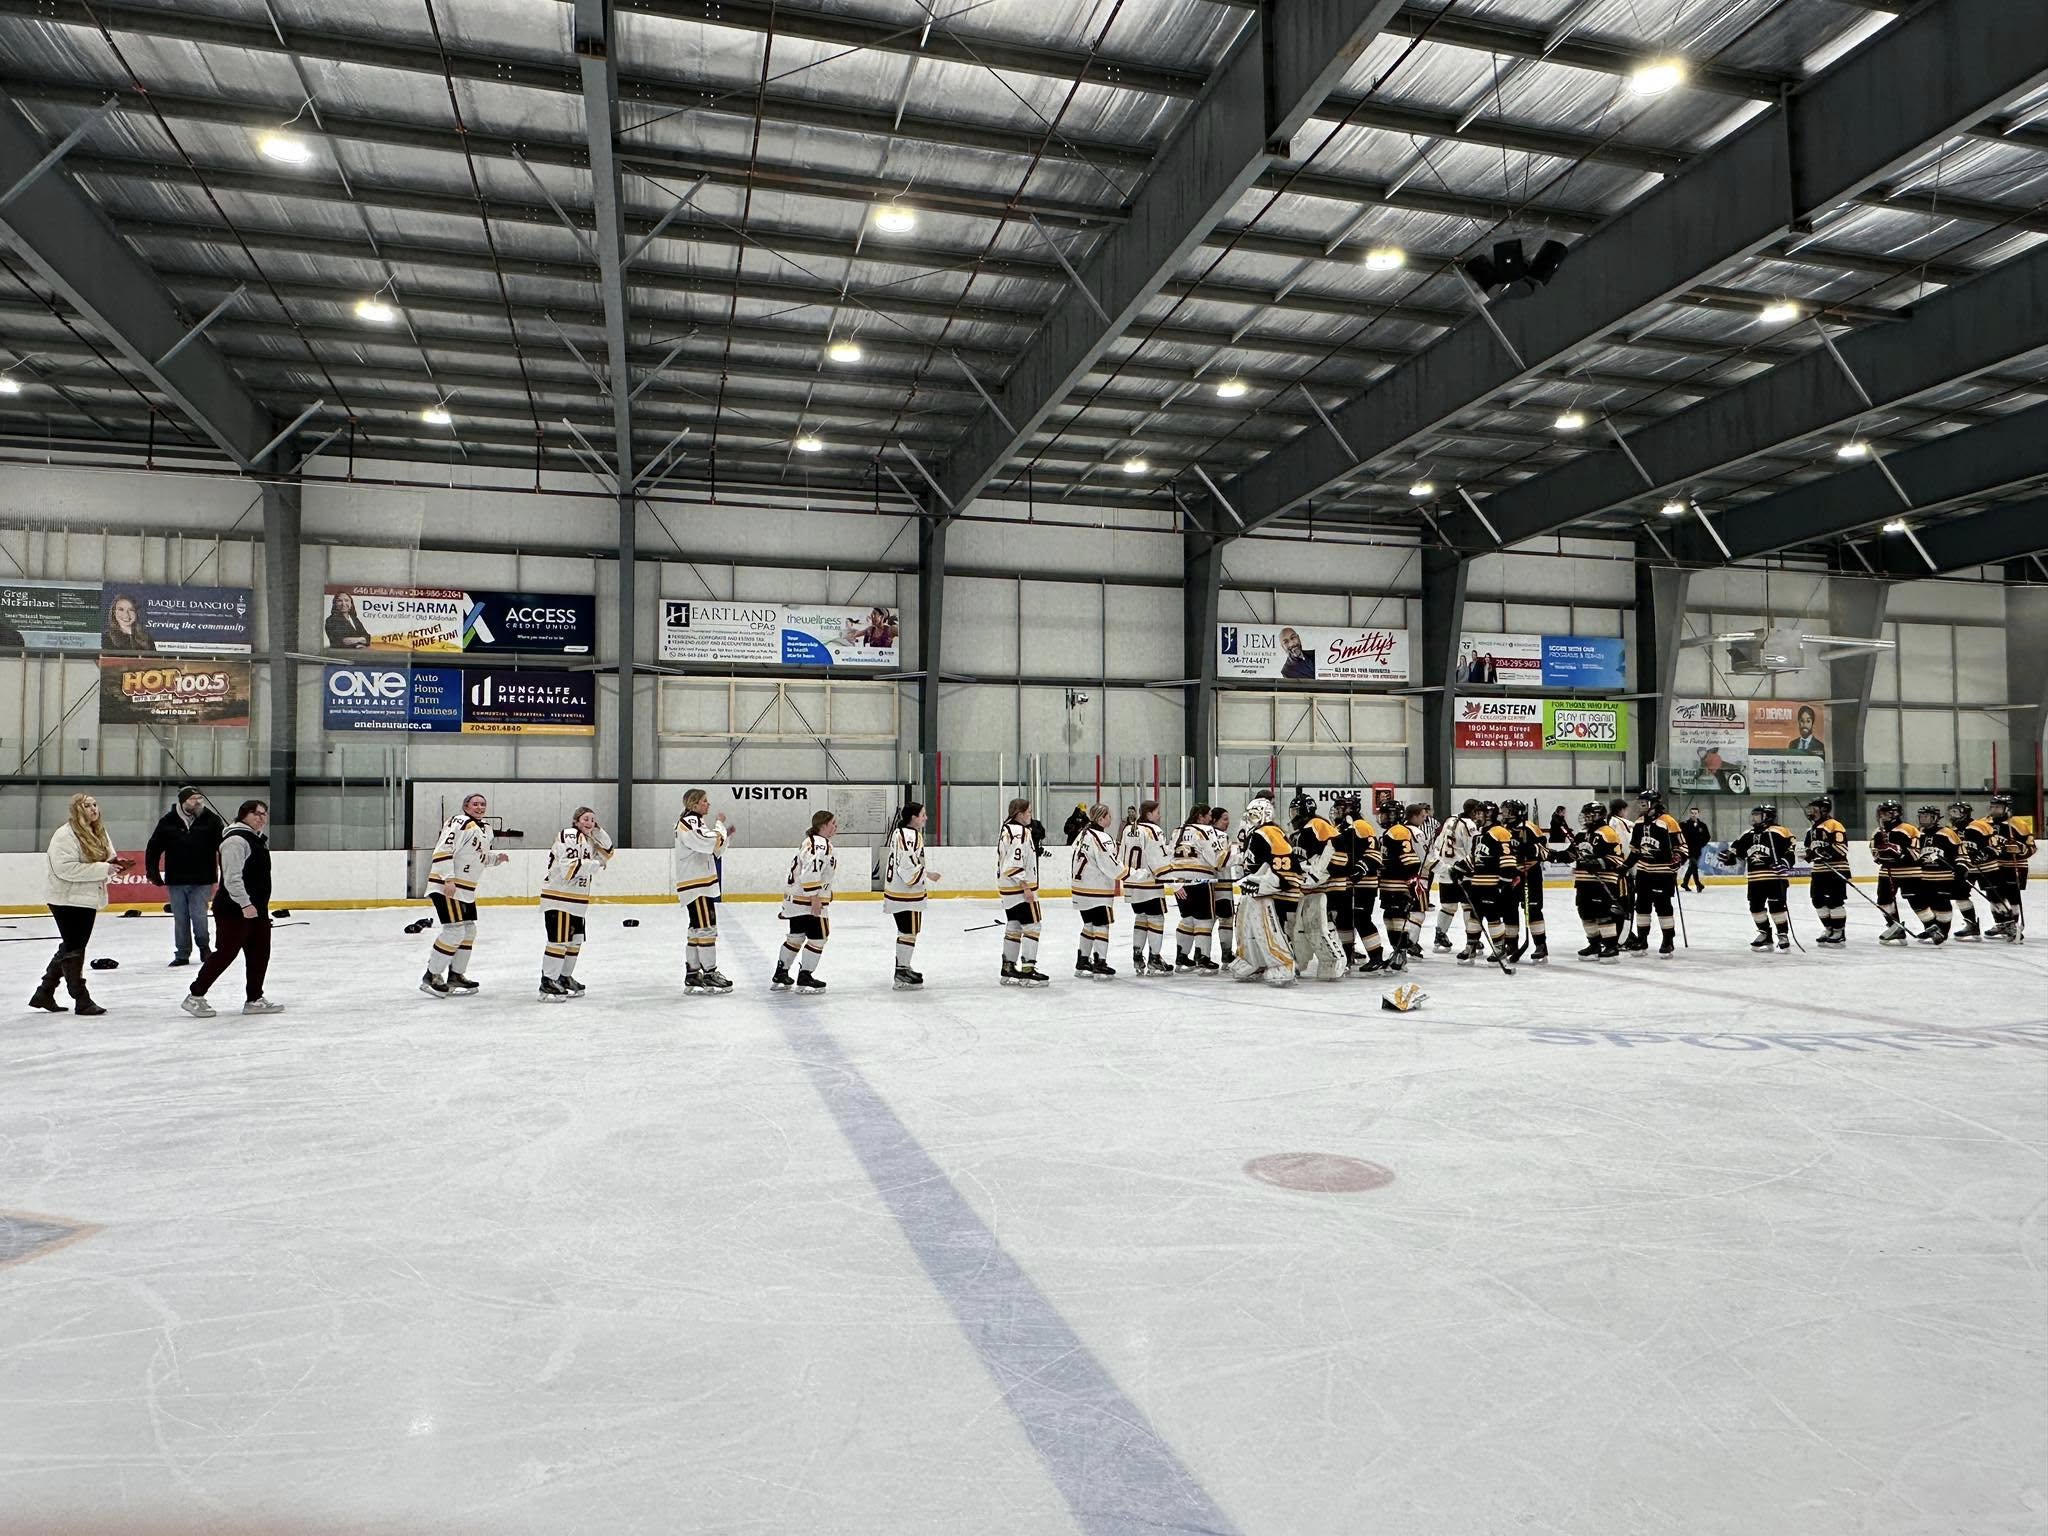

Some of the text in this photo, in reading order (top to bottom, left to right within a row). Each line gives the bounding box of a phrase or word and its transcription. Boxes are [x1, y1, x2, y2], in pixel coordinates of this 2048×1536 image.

[3, 589, 29, 601] Greg
[1, 598, 56, 608] McFarlane
[148, 599, 235, 610] RAQUEL DANCHO
[362, 600, 458, 614] Devi SHARMA
[505, 607, 577, 624] ACCESS
[145, 619, 247, 633] Serving the community
[749, 622, 776, 631] CPAs
[381, 623, 443, 645] STAY ACTIVE!
[412, 629, 459, 649] HAVE FUN!
[1243, 633, 1276, 649] JEM
[1327, 631, 1398, 664] Smitty's
[123, 669, 179, 694] HOT
[175, 673, 227, 694] 100.5
[414, 673, 439, 682] Auto
[414, 684, 444, 693] Home
[498, 685, 571, 695] DUNCALFE
[332, 698, 405, 706] INSURANCE
[414, 695, 440, 704] Farm
[498, 695, 587, 705] MECHANICAL
[413, 706, 458, 716] Business
[1482, 703, 1537, 715] EASTERN
[1557, 712, 1614, 722] PLAY IT AGAIN
[354, 720, 432, 730] oneinsurance.ca
[1557, 721, 1615, 739] SPORTS
[731, 786, 808, 800] VISITOR
[444, 832, 456, 845] 2
[1402, 840, 1412, 853] 3
[463, 864, 471, 873] 2
[812, 859, 825, 873] 17
[1272, 857, 1292, 871] 33
